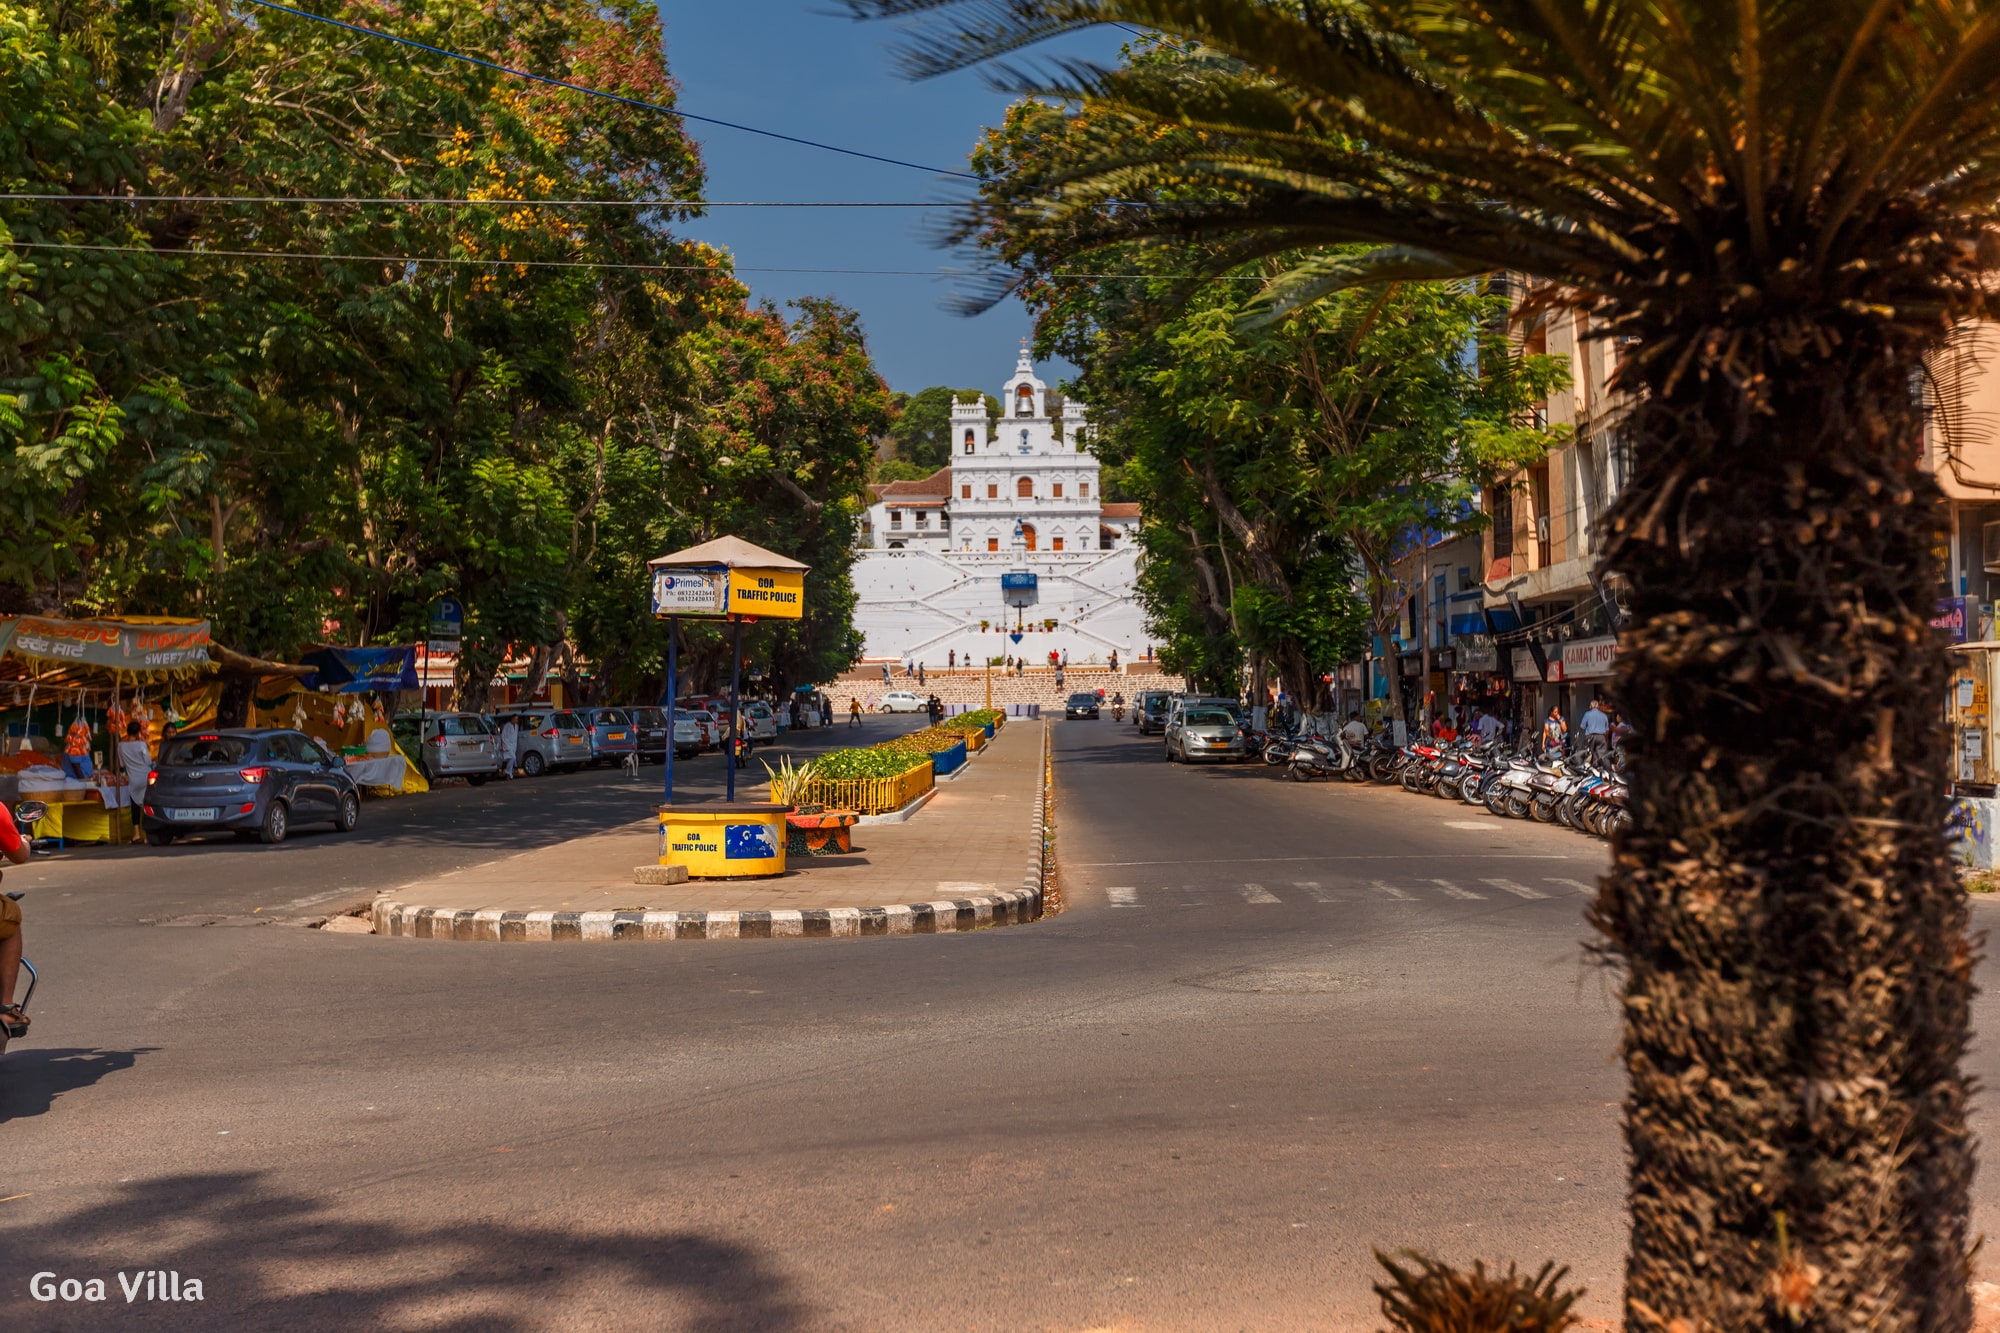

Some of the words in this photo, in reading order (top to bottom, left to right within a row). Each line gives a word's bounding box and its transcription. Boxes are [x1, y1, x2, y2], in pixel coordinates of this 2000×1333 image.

[757, 578, 774, 588] GOA
[737, 589, 769, 600] TRAFFIC
[770, 591, 797, 603] POLICE
[145, 652, 185, 665] SWEET
[1565, 647, 1594, 664] KAMAT
[687, 833, 701, 841] GOA
[672, 843, 694, 852] TRAFFIC
[695, 844, 717, 852] POLICE
